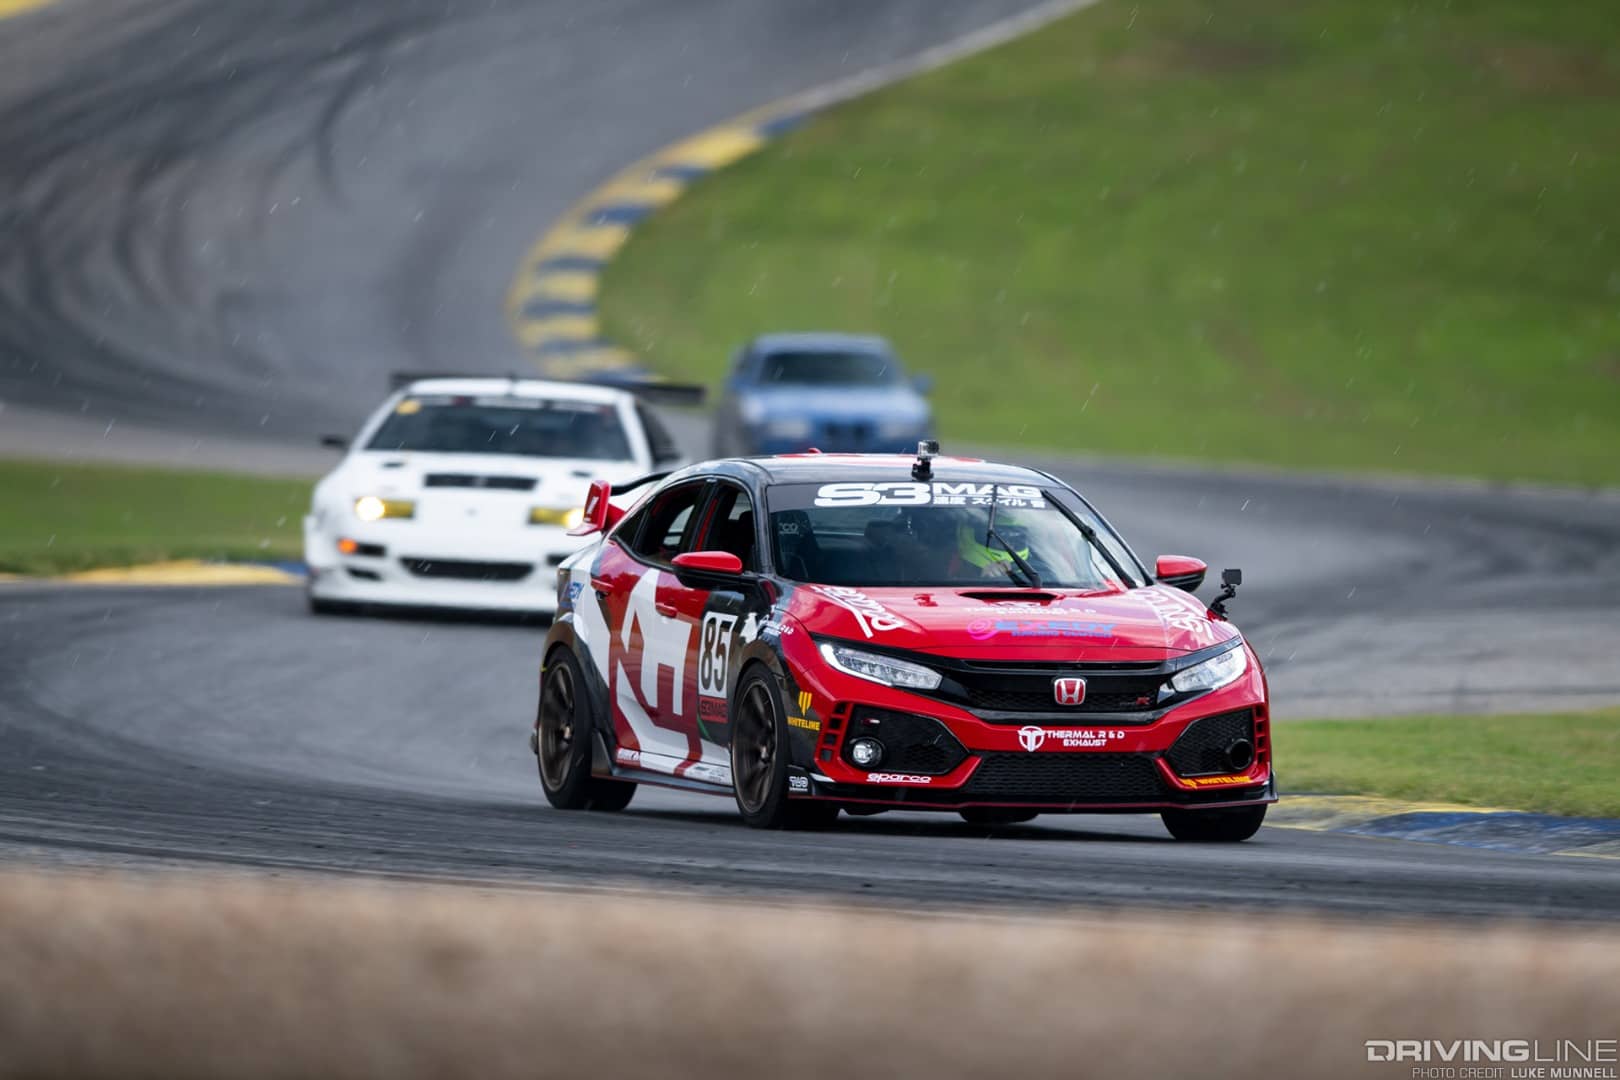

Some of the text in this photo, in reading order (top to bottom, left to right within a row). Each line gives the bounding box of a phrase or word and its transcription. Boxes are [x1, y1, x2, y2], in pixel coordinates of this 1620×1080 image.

[815, 482, 932, 507] S3
[933, 482, 1042, 498] MAG
[702, 617, 733, 692] 85
[1046, 730, 1125, 739] THERMAL R & D
[1063, 739, 1107, 747] EXHAUST
[866, 773, 932, 784] sparco
